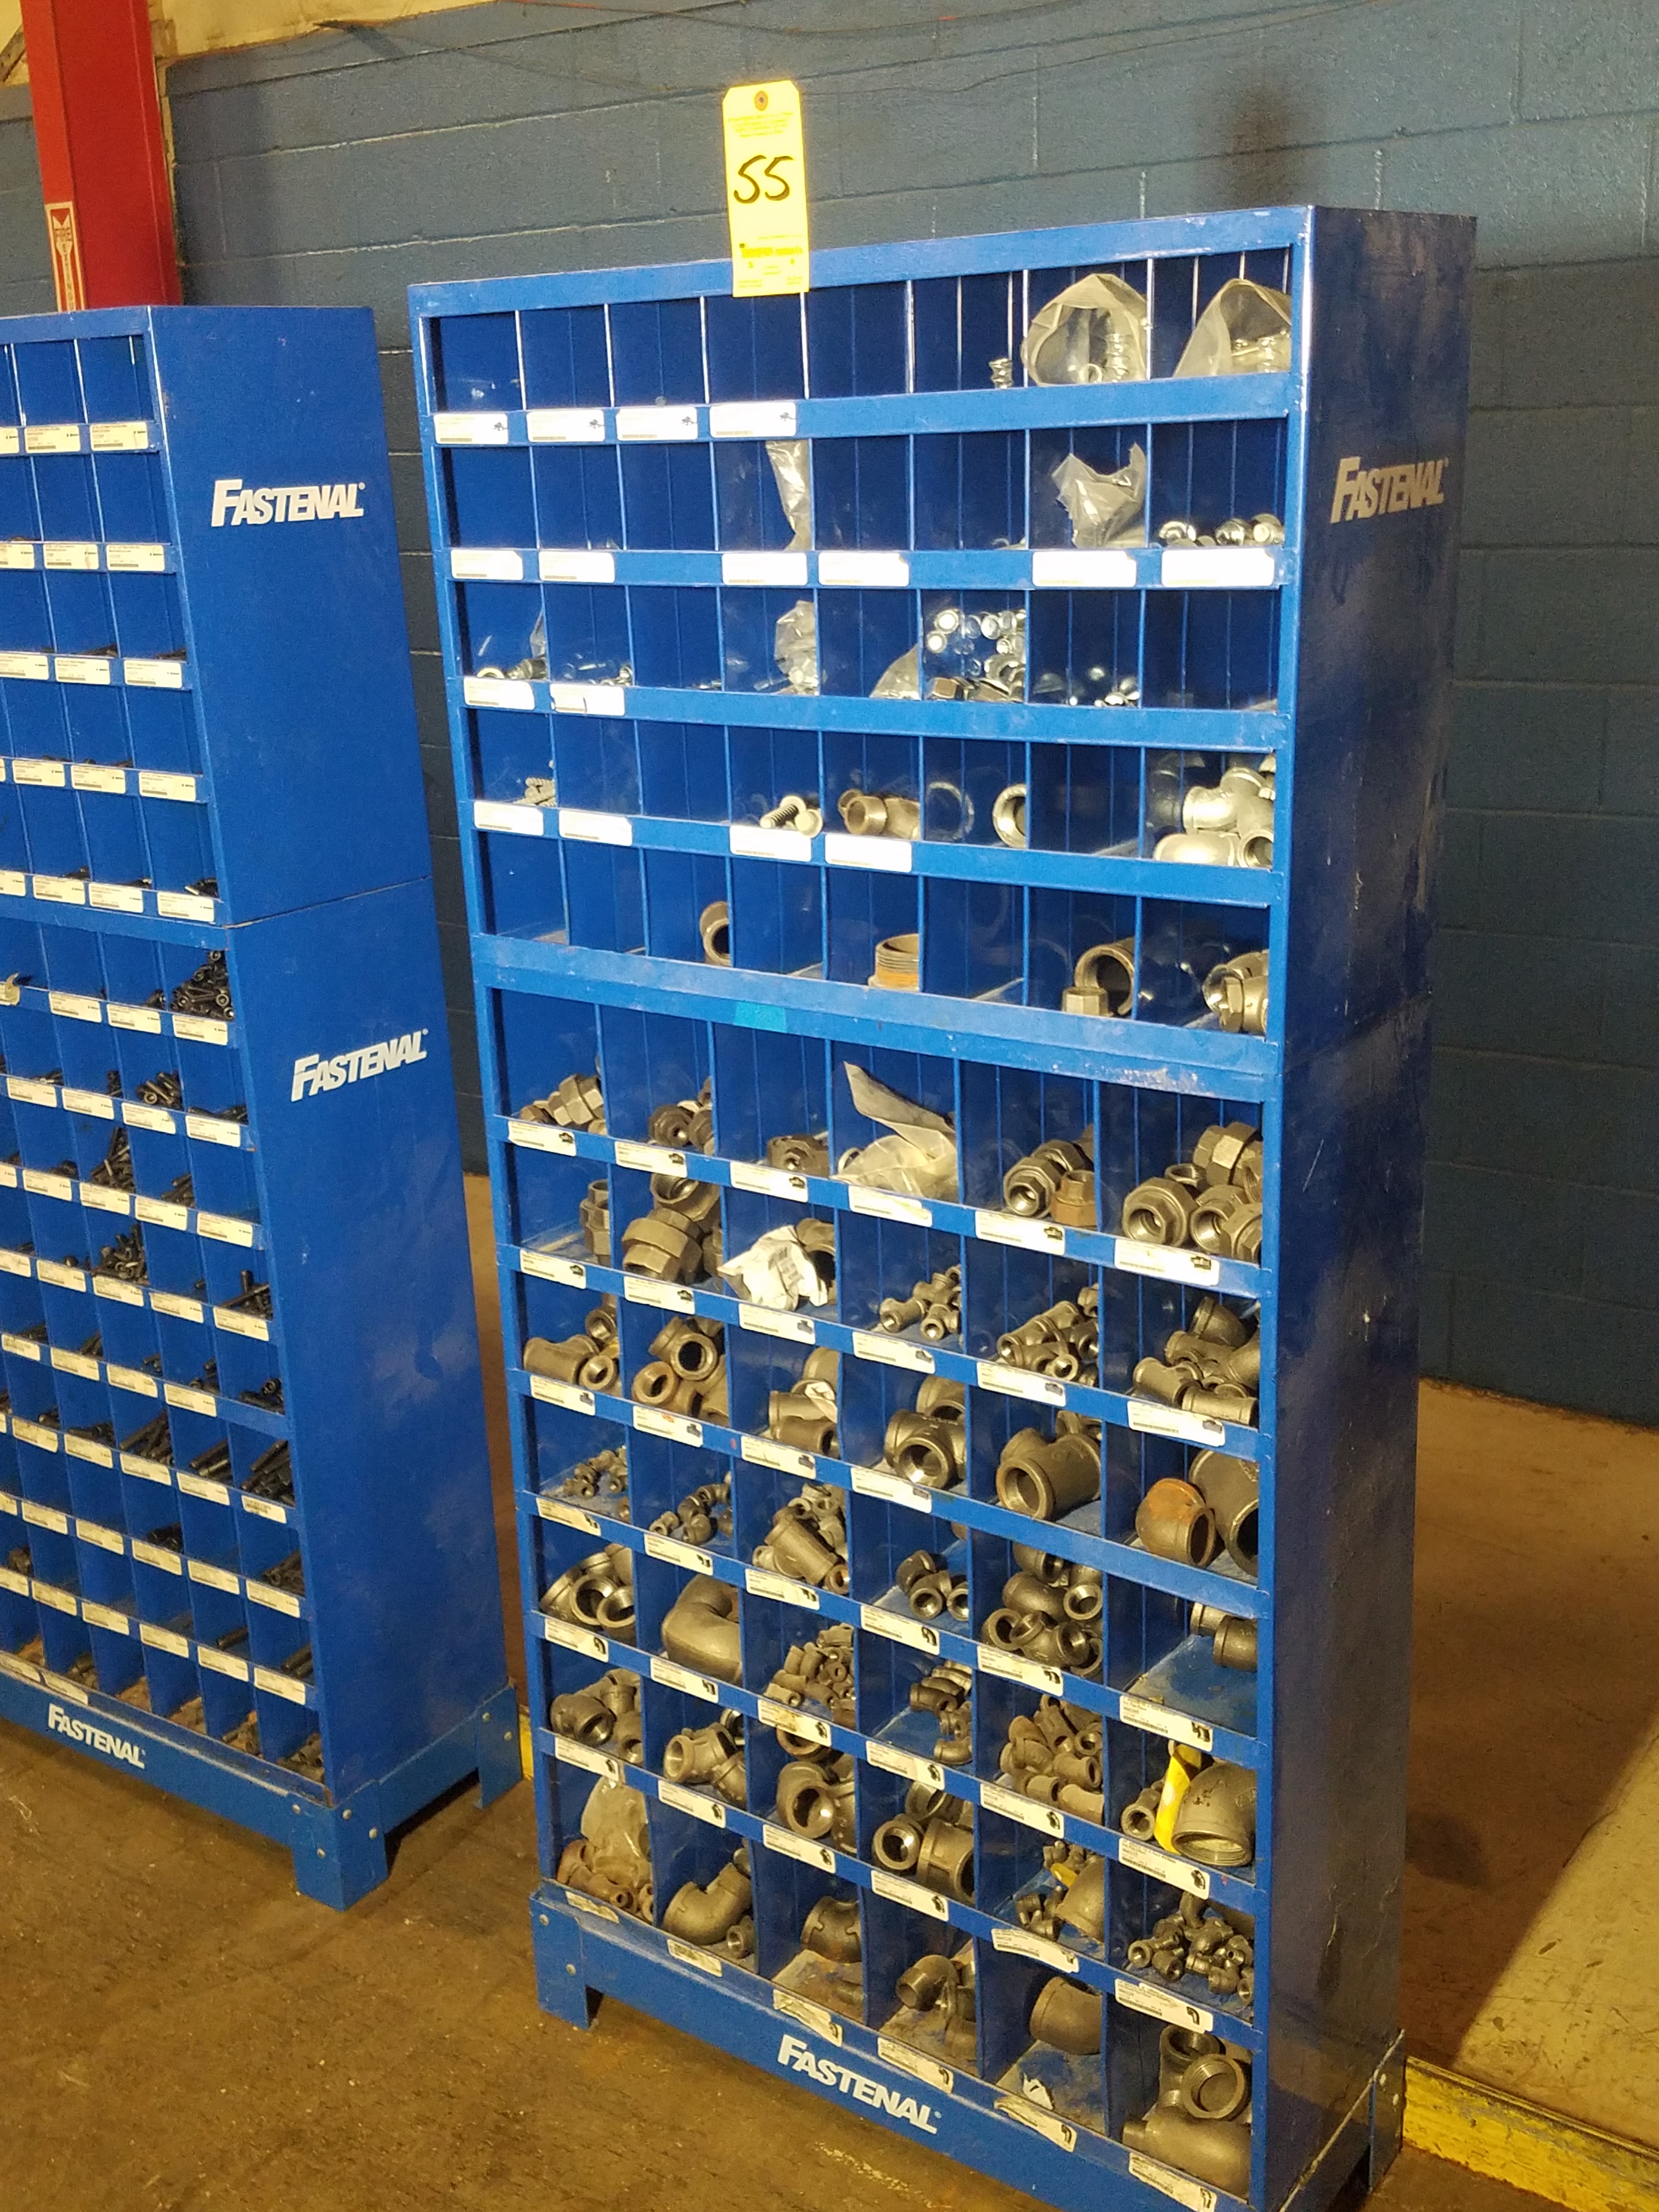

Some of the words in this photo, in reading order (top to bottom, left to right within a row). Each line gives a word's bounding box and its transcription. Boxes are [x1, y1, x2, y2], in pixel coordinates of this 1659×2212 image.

[211, 479, 364, 527] FASTENAL
[1330, 456, 1444, 523] FASTENAL
[291, 1031, 427, 1102] FASTENAL
[48, 1703, 145, 1769] FASTENAL
[777, 2034, 938, 2134] FASTENAL
